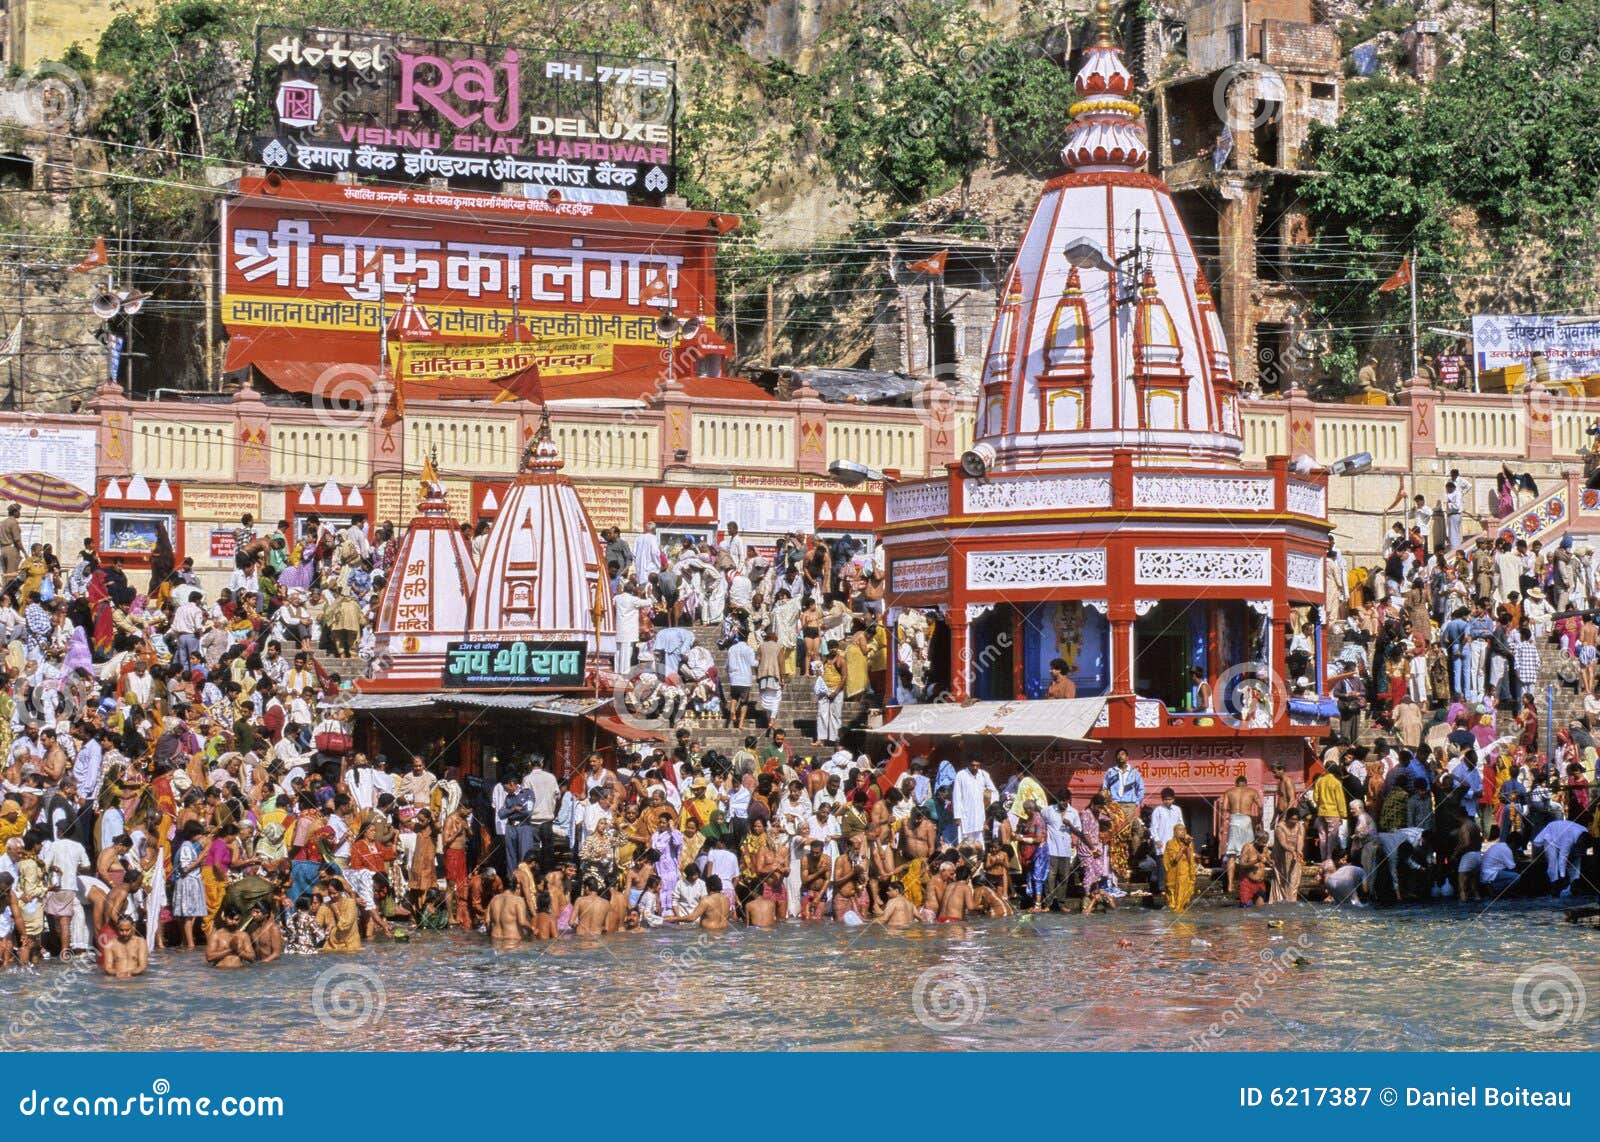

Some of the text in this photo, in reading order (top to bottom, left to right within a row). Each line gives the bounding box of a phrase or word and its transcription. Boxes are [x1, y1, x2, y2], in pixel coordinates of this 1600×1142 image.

[395, 48, 520, 132] Raj
[530, 115, 669, 143] DELUXE
[337, 124, 669, 165] VISHNU GHAT HARDWAR
[296, 145, 352, 171] हमारा
[355, 144, 399, 171] बैंक
[402, 148, 490, 177] इण्डियन
[594, 160, 638, 187] बैंक
[234, 219, 316, 288] श्री
[447, 241, 525, 300] का
[531, 238, 684, 308] लंगर
[233, 301, 302, 325] सनातन
[445, 308, 484, 333] सेवा
[407, 560, 426, 577] श्री
[404, 578, 428, 600] हरि
[397, 618, 429, 630] मन्दिर
[399, 604, 430, 618] चरण
[449, 641, 581, 675] जय श्री राम
[1194, 761, 1230, 778] गणेश
[1233, 762, 1248, 777] जी
